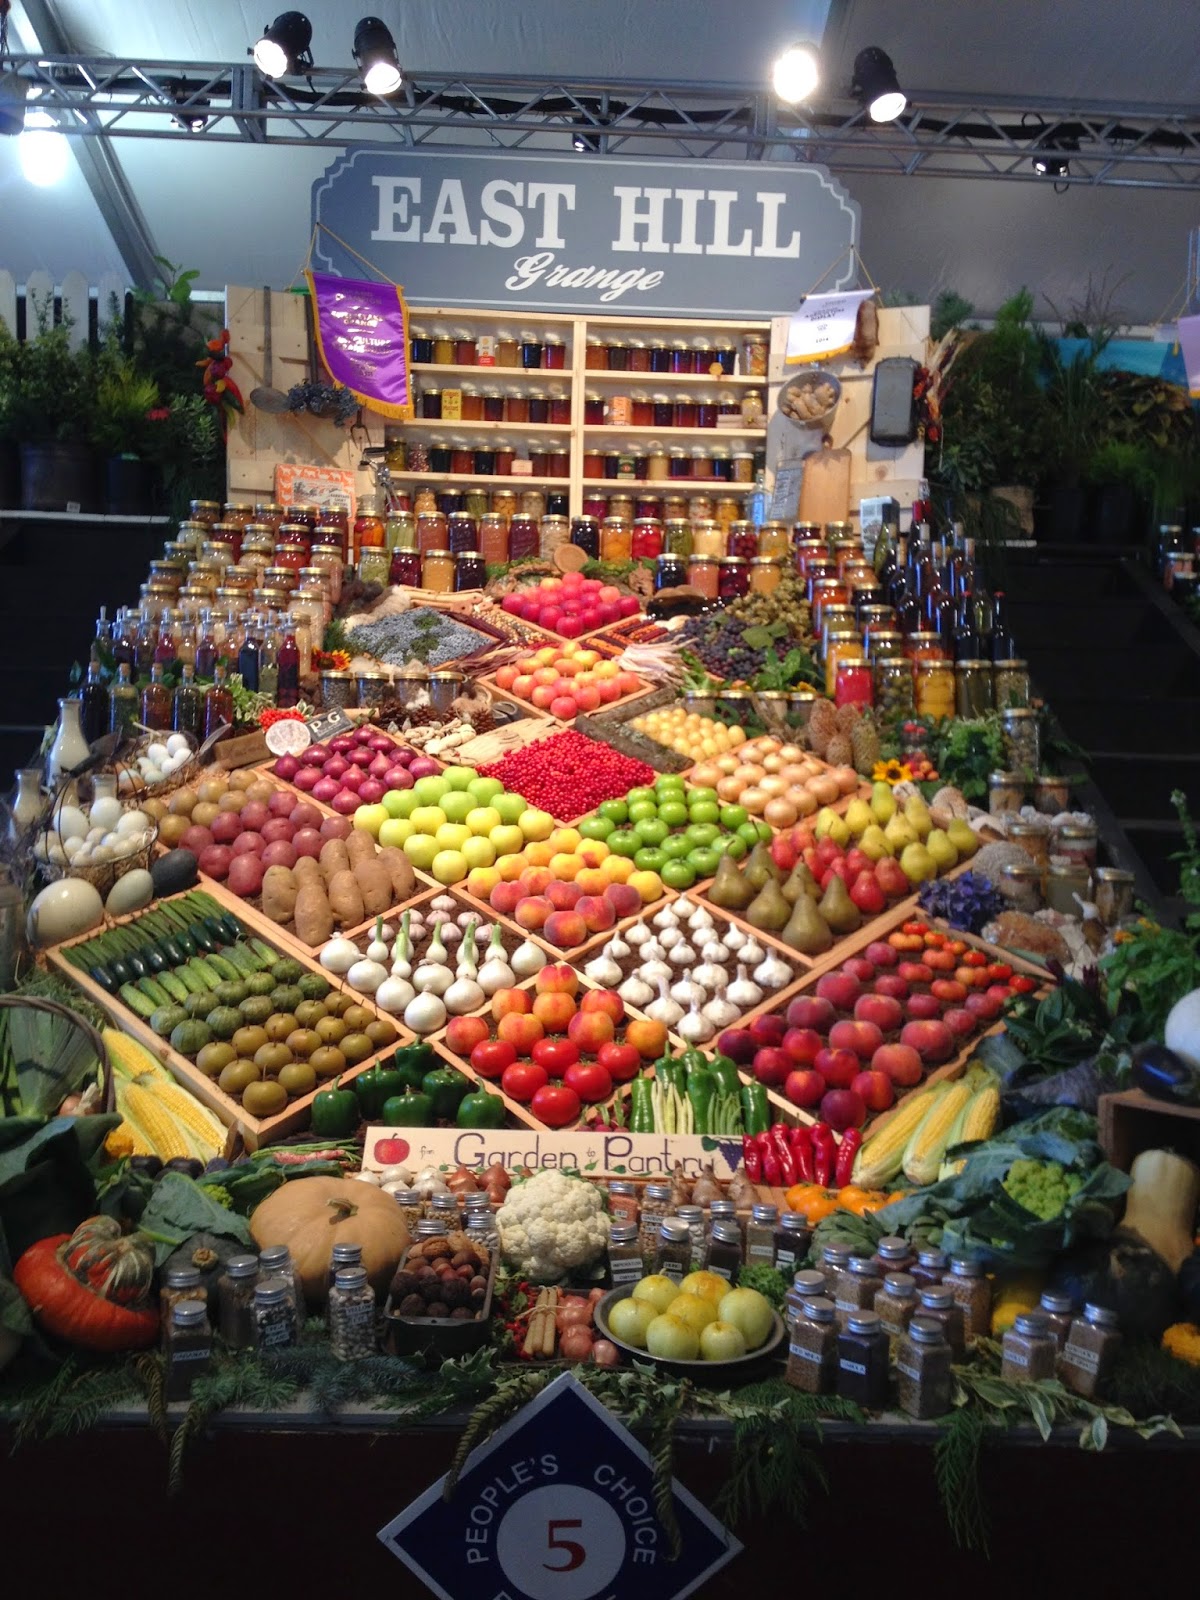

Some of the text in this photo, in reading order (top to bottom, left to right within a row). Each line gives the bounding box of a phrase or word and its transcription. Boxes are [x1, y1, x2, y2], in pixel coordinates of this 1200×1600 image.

[370, 176, 801, 259] EAST HILL
[505, 252, 665, 302] Grange
[309, 720, 322, 733] P
[327, 711, 341, 723] G
[453, 1132, 578, 1169] Garden
[604, 1136, 716, 1179] Pantry
[466, 1454, 657, 1564] PEOPLE'S CHOICE
[542, 1519, 586, 1572] 5
